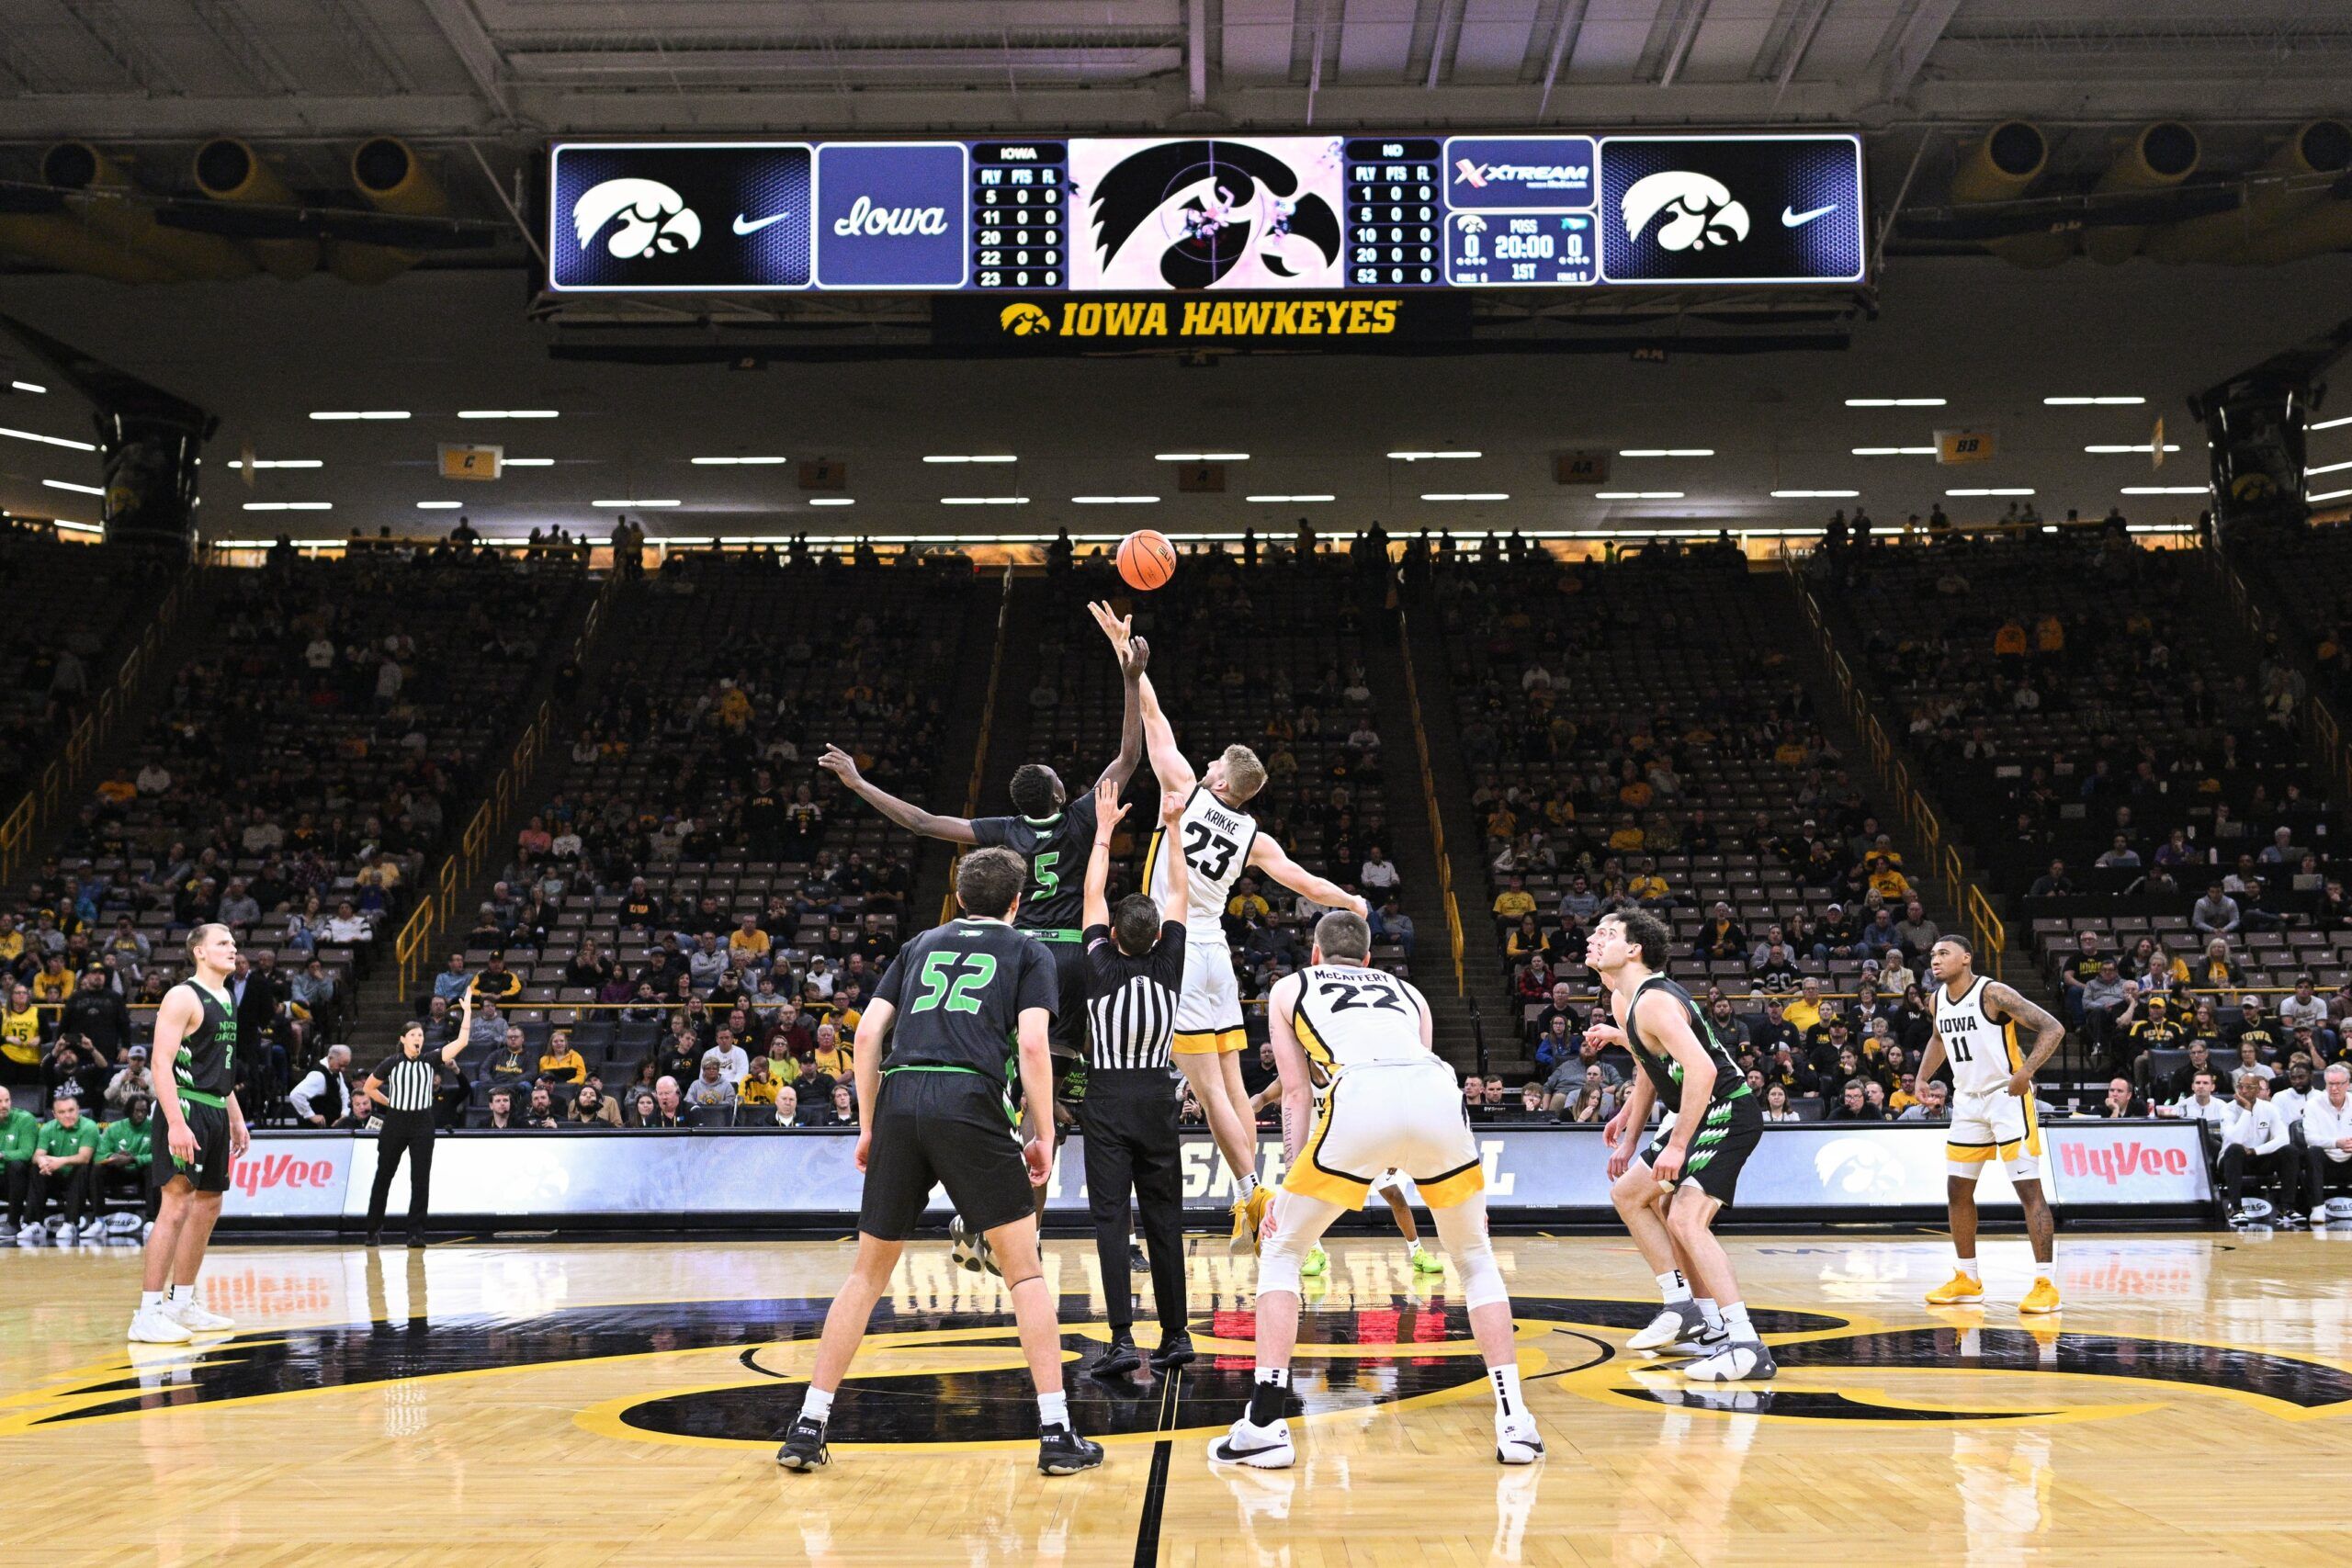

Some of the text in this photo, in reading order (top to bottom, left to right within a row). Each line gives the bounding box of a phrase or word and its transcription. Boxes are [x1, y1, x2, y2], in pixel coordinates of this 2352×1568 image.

[1001, 148, 1037, 160] IOWA
[1383, 144, 1404, 157] ND
[981, 169, 1056, 185] PLY PTS FL
[1355, 166, 1430, 182] PLY PTS FL
[1485, 164, 1589, 181] XTREAM
[985, 189, 1057, 204] 5 0 0
[1362, 186, 1431, 201] 1 0 0
[833, 196, 948, 236] Iowa
[982, 210, 1057, 225] 11 0 0
[1361, 207, 1431, 222] 5 0 0
[1510, 220, 1538, 233] POSS
[980, 231, 1057, 245] 20 0 0
[1356, 227, 1431, 243] 10 0 0
[1464, 234, 1479, 258] 0
[1495, 235, 1555, 259] 20:00
[1567, 233, 1583, 257] 0
[980, 251, 1057, 265] 22 0 0
[1356, 247, 1431, 263] 20 0 0
[980, 272, 1057, 287] 23 0 0
[1357, 268, 1431, 284] 52 0 0
[1511, 264, 1536, 279] 1ST
[1059, 300, 1398, 335] IOWA HAWKEYES
[1955, 439, 1979, 453] BB
[1204, 808, 1238, 835] KRIKKE
[1183, 821, 1238, 882] 23
[1031, 852, 1059, 901] 5
[911, 952, 997, 1015] 52
[1766, 972, 1792, 992] 20
[1319, 982, 1408, 1015] 22
[1939, 1016, 1978, 1033] IOWA
[225, 1044, 233, 1069] 2
[1951, 1036, 1973, 1063] 11
[2060, 1142, 2188, 1185] HyVee
